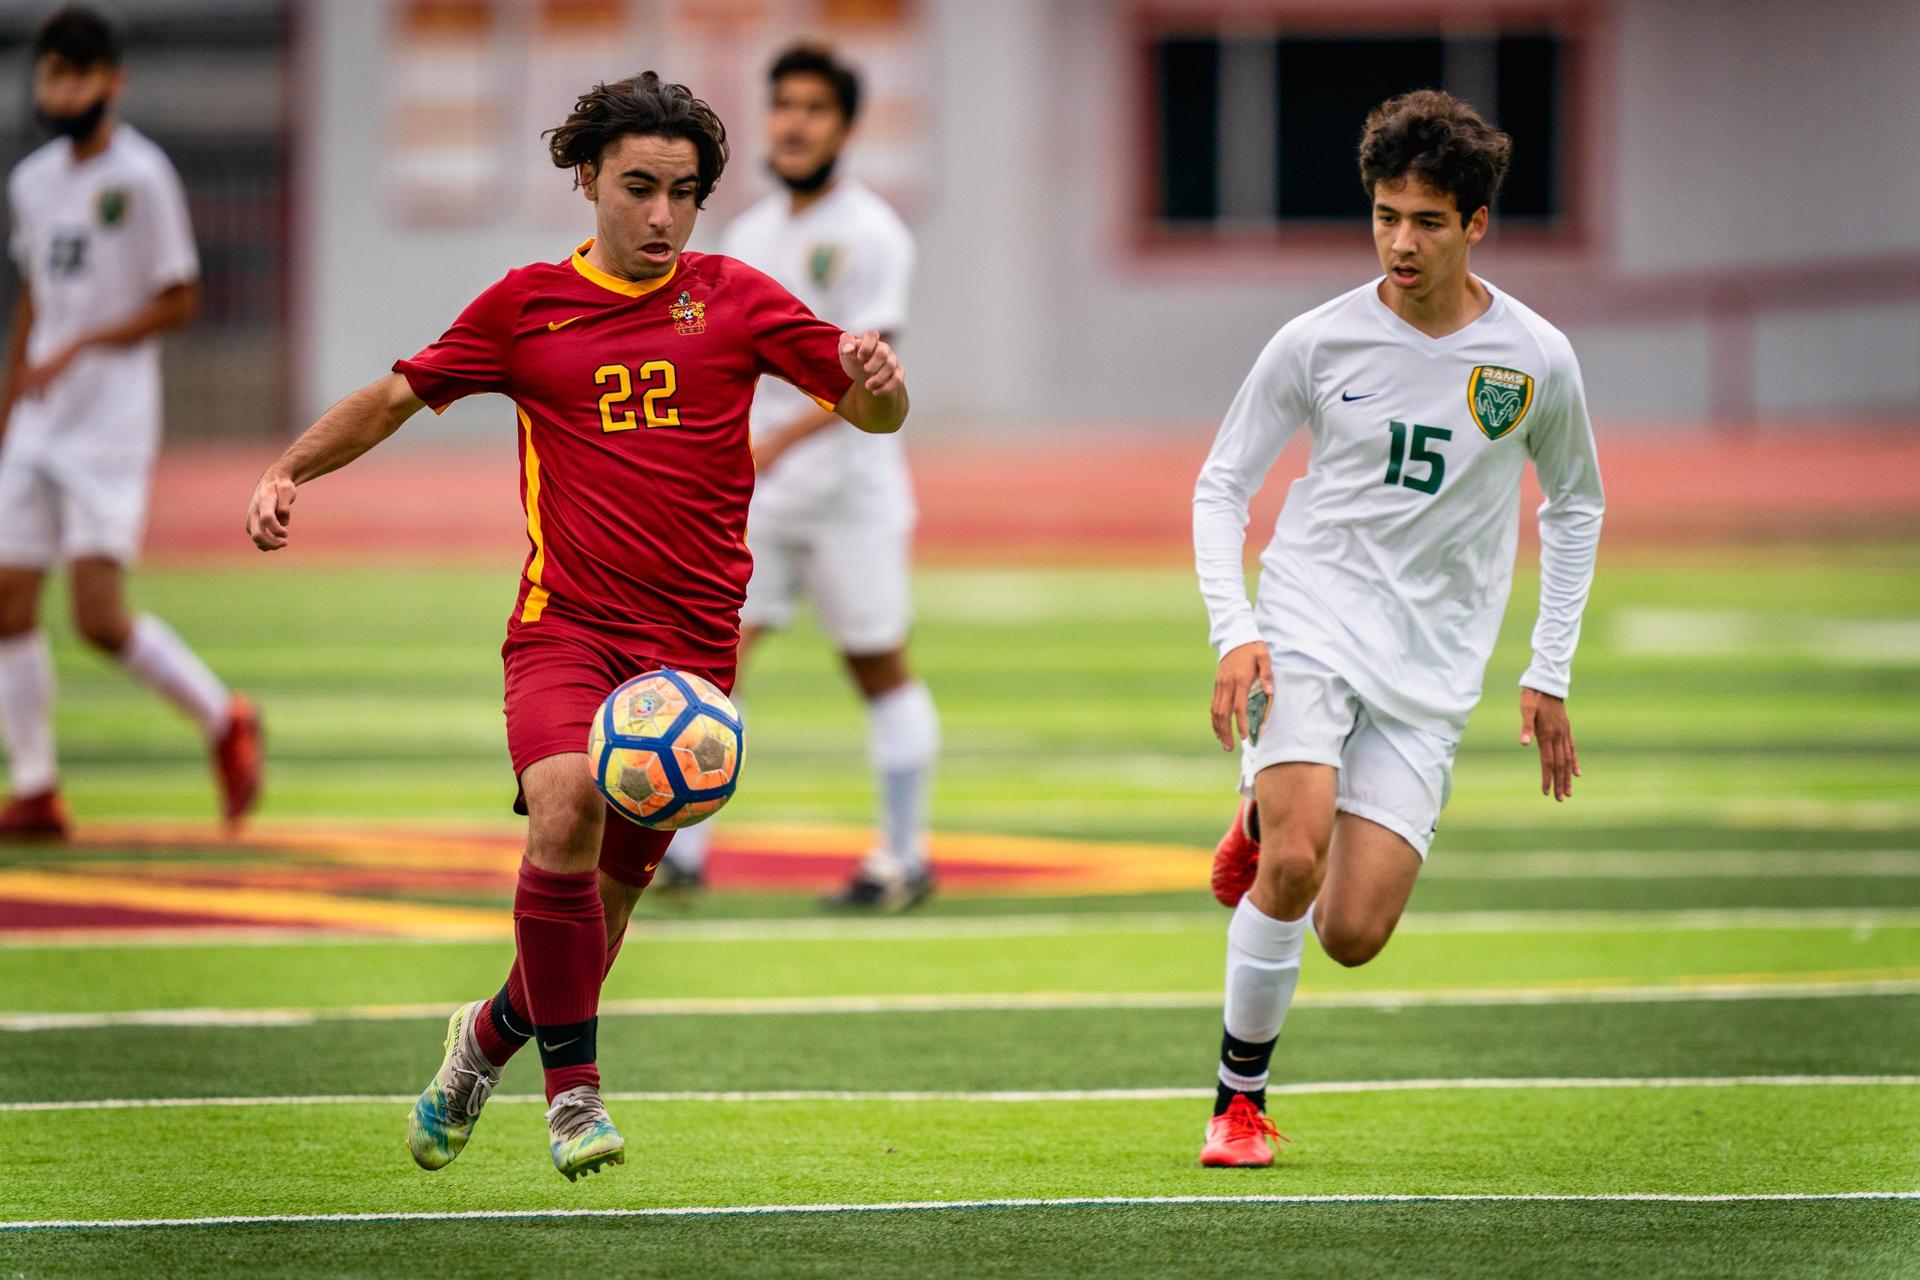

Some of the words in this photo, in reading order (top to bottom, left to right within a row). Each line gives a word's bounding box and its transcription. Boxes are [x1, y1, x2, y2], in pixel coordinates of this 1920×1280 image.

[594, 359, 681, 433] 22
[1482, 368, 1525, 384] RAMS
[1484, 379, 1520, 390] SOCCER
[1384, 421, 1453, 495] 15
